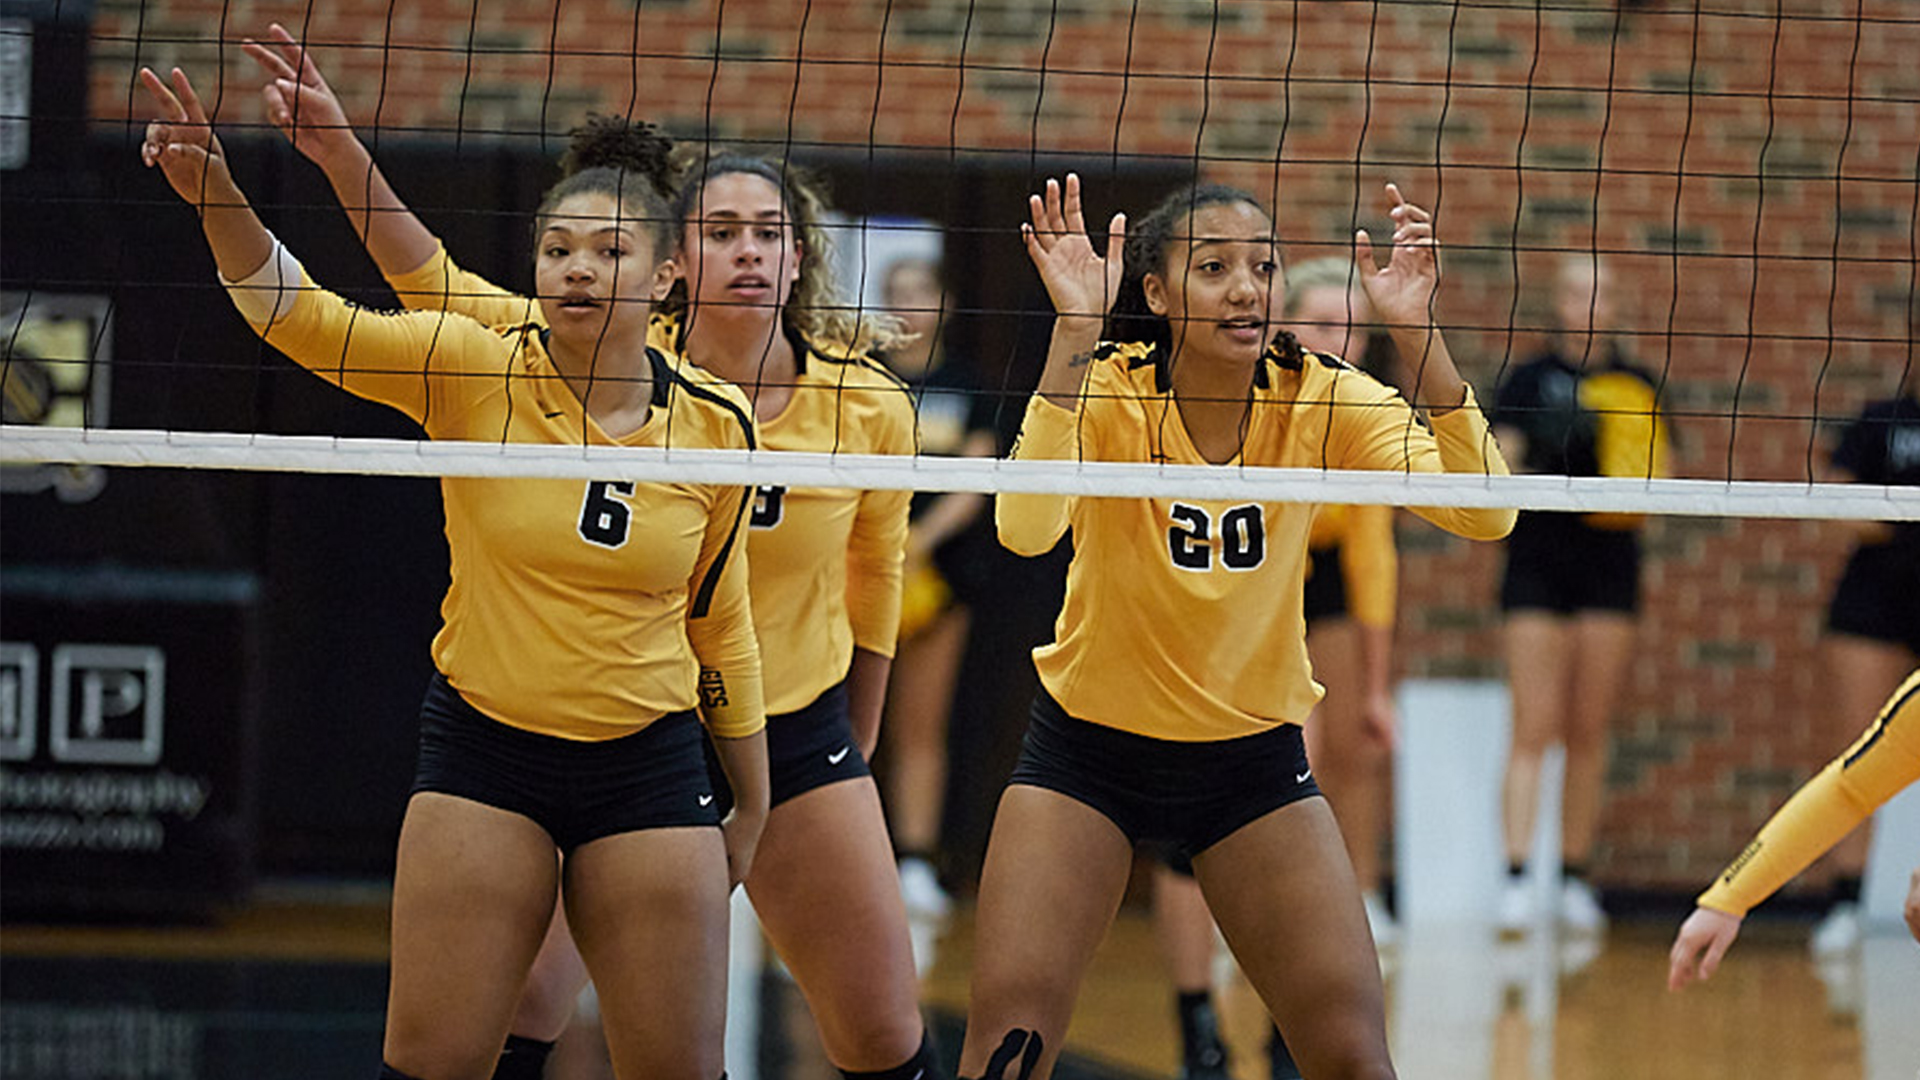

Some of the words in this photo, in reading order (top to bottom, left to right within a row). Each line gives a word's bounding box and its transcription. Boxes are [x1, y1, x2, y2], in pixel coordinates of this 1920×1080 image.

[578, 480, 635, 550] 6
[1167, 501, 1266, 573] 20
[81, 668, 143, 737] P
